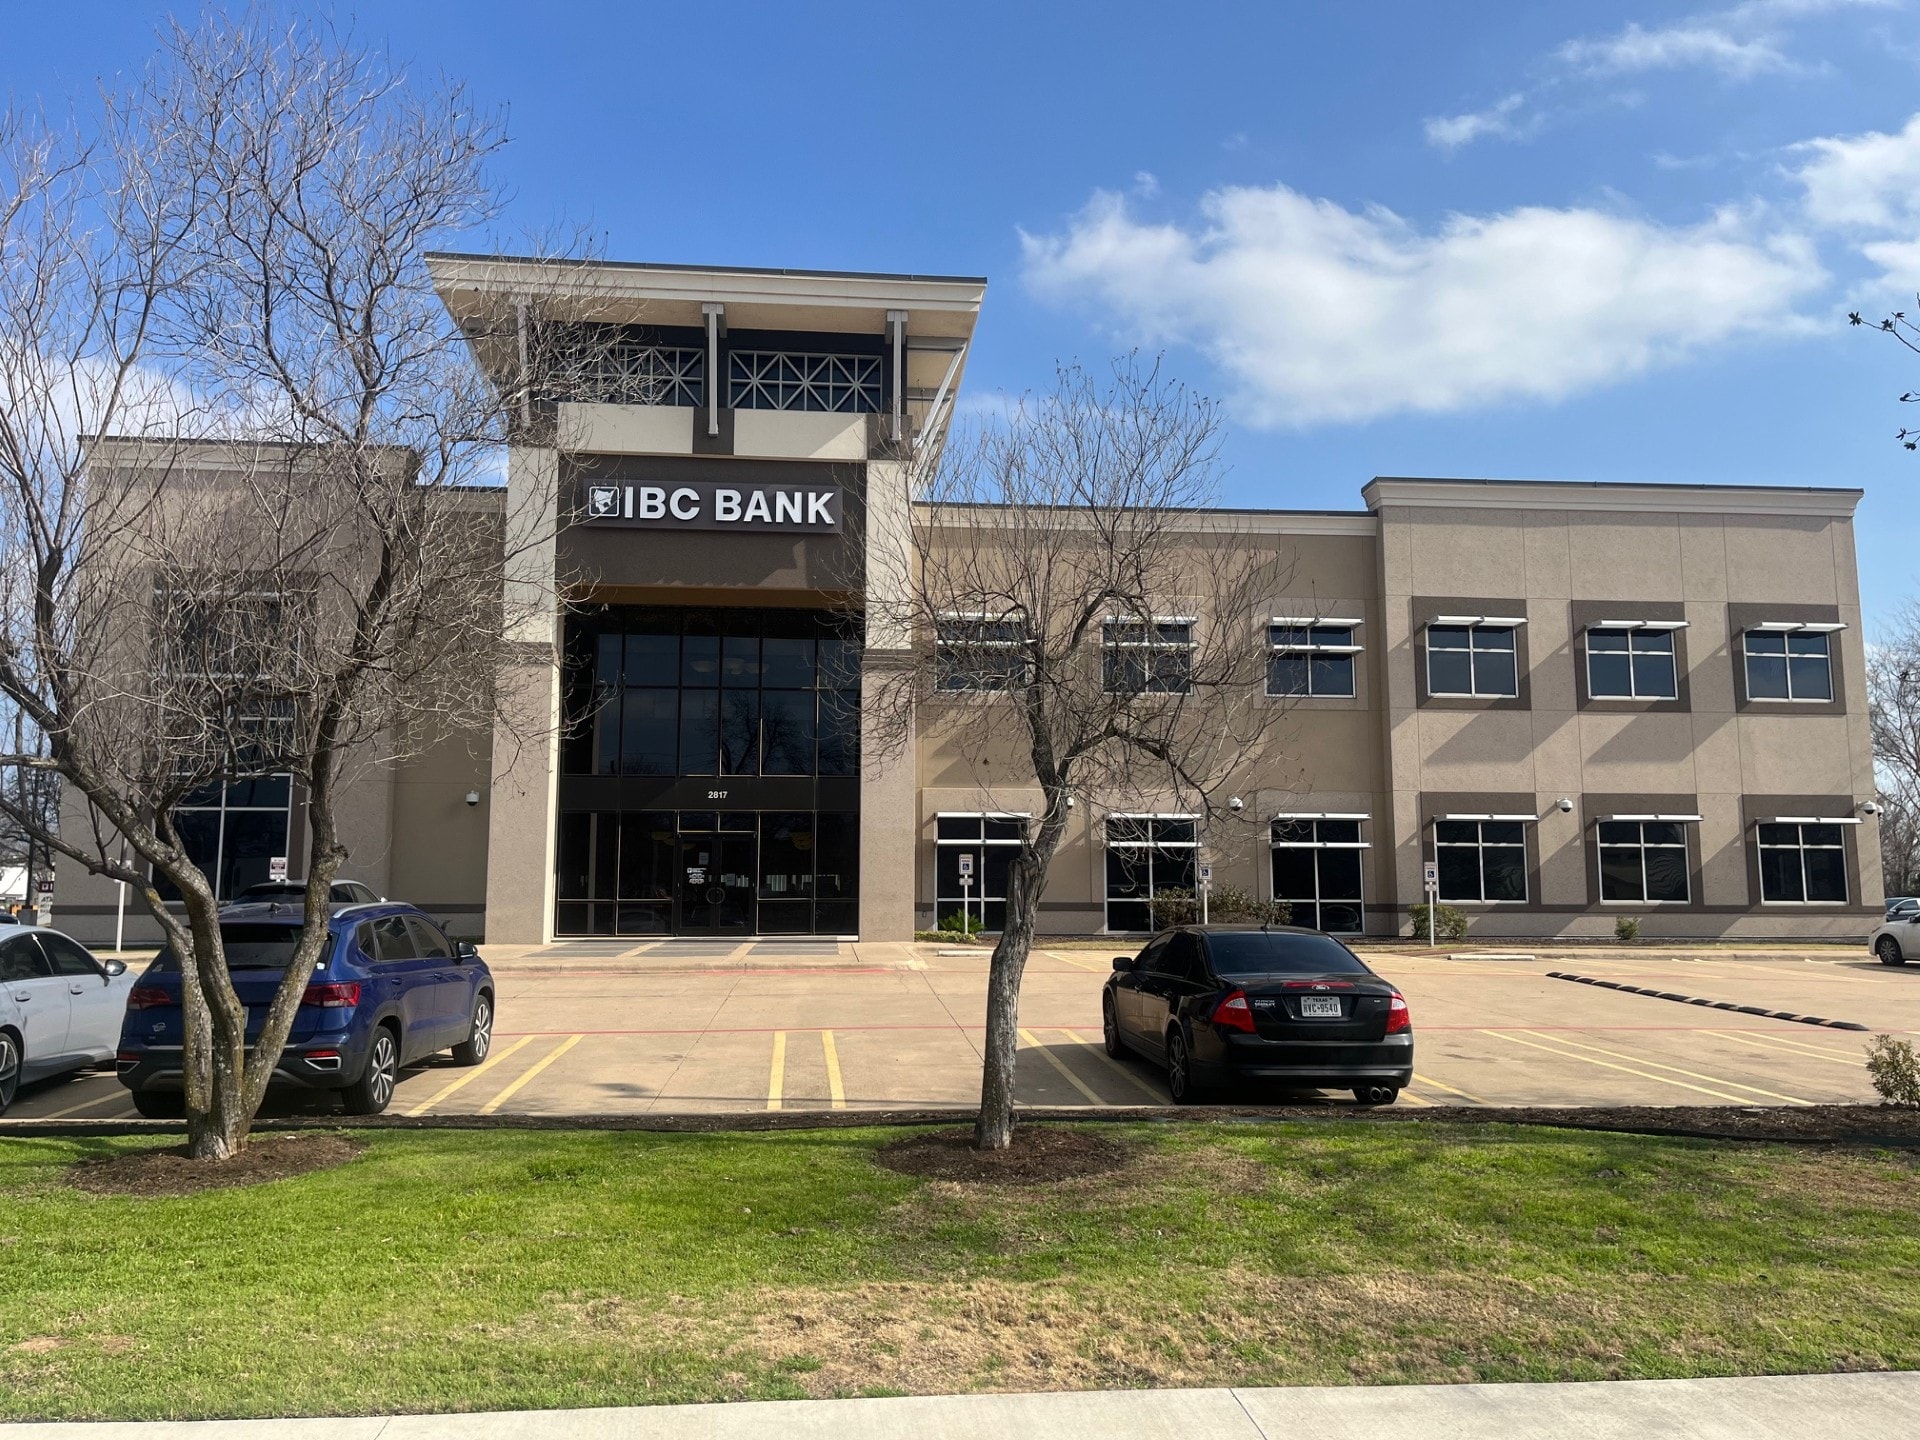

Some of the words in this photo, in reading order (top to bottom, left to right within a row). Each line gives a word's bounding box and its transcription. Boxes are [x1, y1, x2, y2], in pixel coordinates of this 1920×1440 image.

[624, 486, 700, 520] IBC
[715, 488, 835, 524] BANK
[707, 790, 728, 799] 2817
